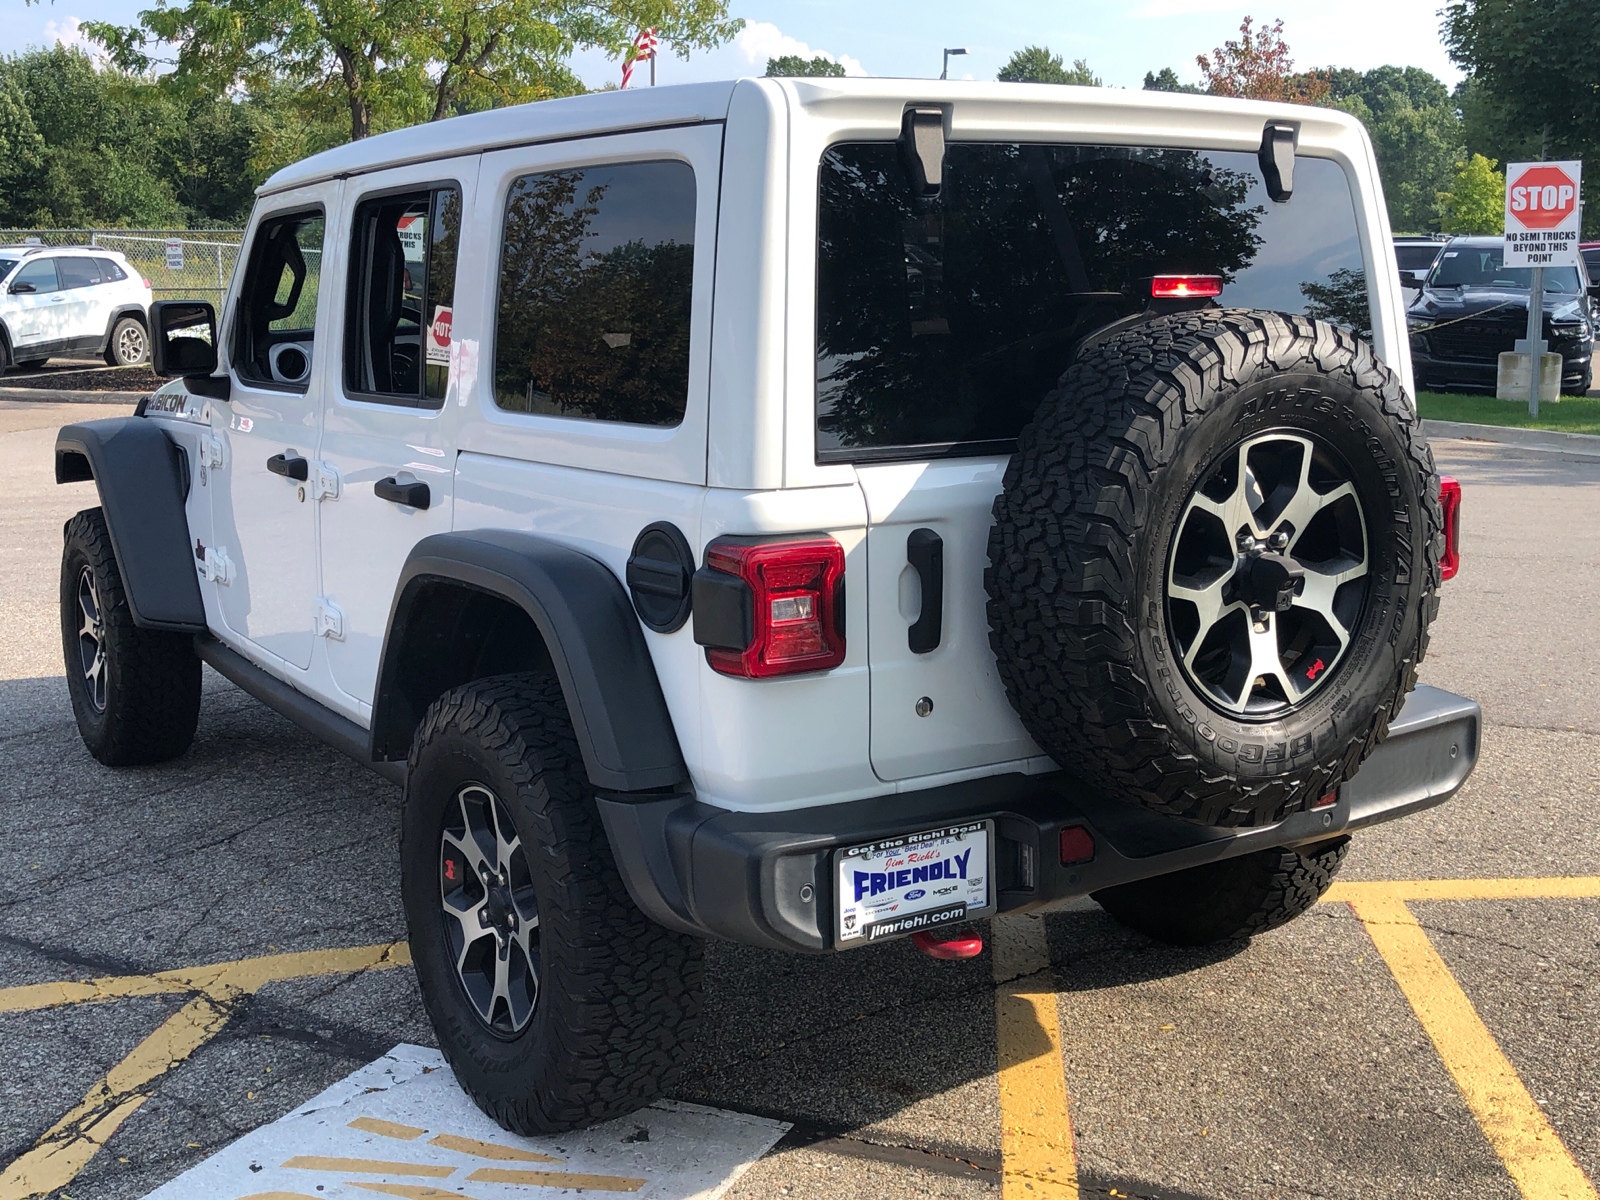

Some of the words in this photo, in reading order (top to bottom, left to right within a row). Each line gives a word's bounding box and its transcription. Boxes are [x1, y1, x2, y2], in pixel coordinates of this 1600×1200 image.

[1511, 185, 1574, 211] STOP
[1506, 232, 1518, 242] NO
[1519, 232, 1540, 241] SEMI
[1542, 231, 1576, 241] TRUCKS
[1513, 243, 1546, 252] BEYOND
[1548, 242, 1568, 252] THIS
[1527, 253, 1553, 263] POINT
[146, 394, 188, 413] RUBICON
[848, 845, 875, 856] Get
[879, 840, 904, 849] the
[908, 830, 945, 844] Riehl
[949, 823, 981, 835] Deal
[884, 857, 904, 872] Jim
[907, 849, 941, 864] Riehl's
[885, 848, 901, 858] Your
[853, 847, 972, 903] FRIENDLY
[907, 890, 922, 900] Ford
[933, 885, 958, 895] MOKE
[870, 908, 964, 940] jimriehl.com
